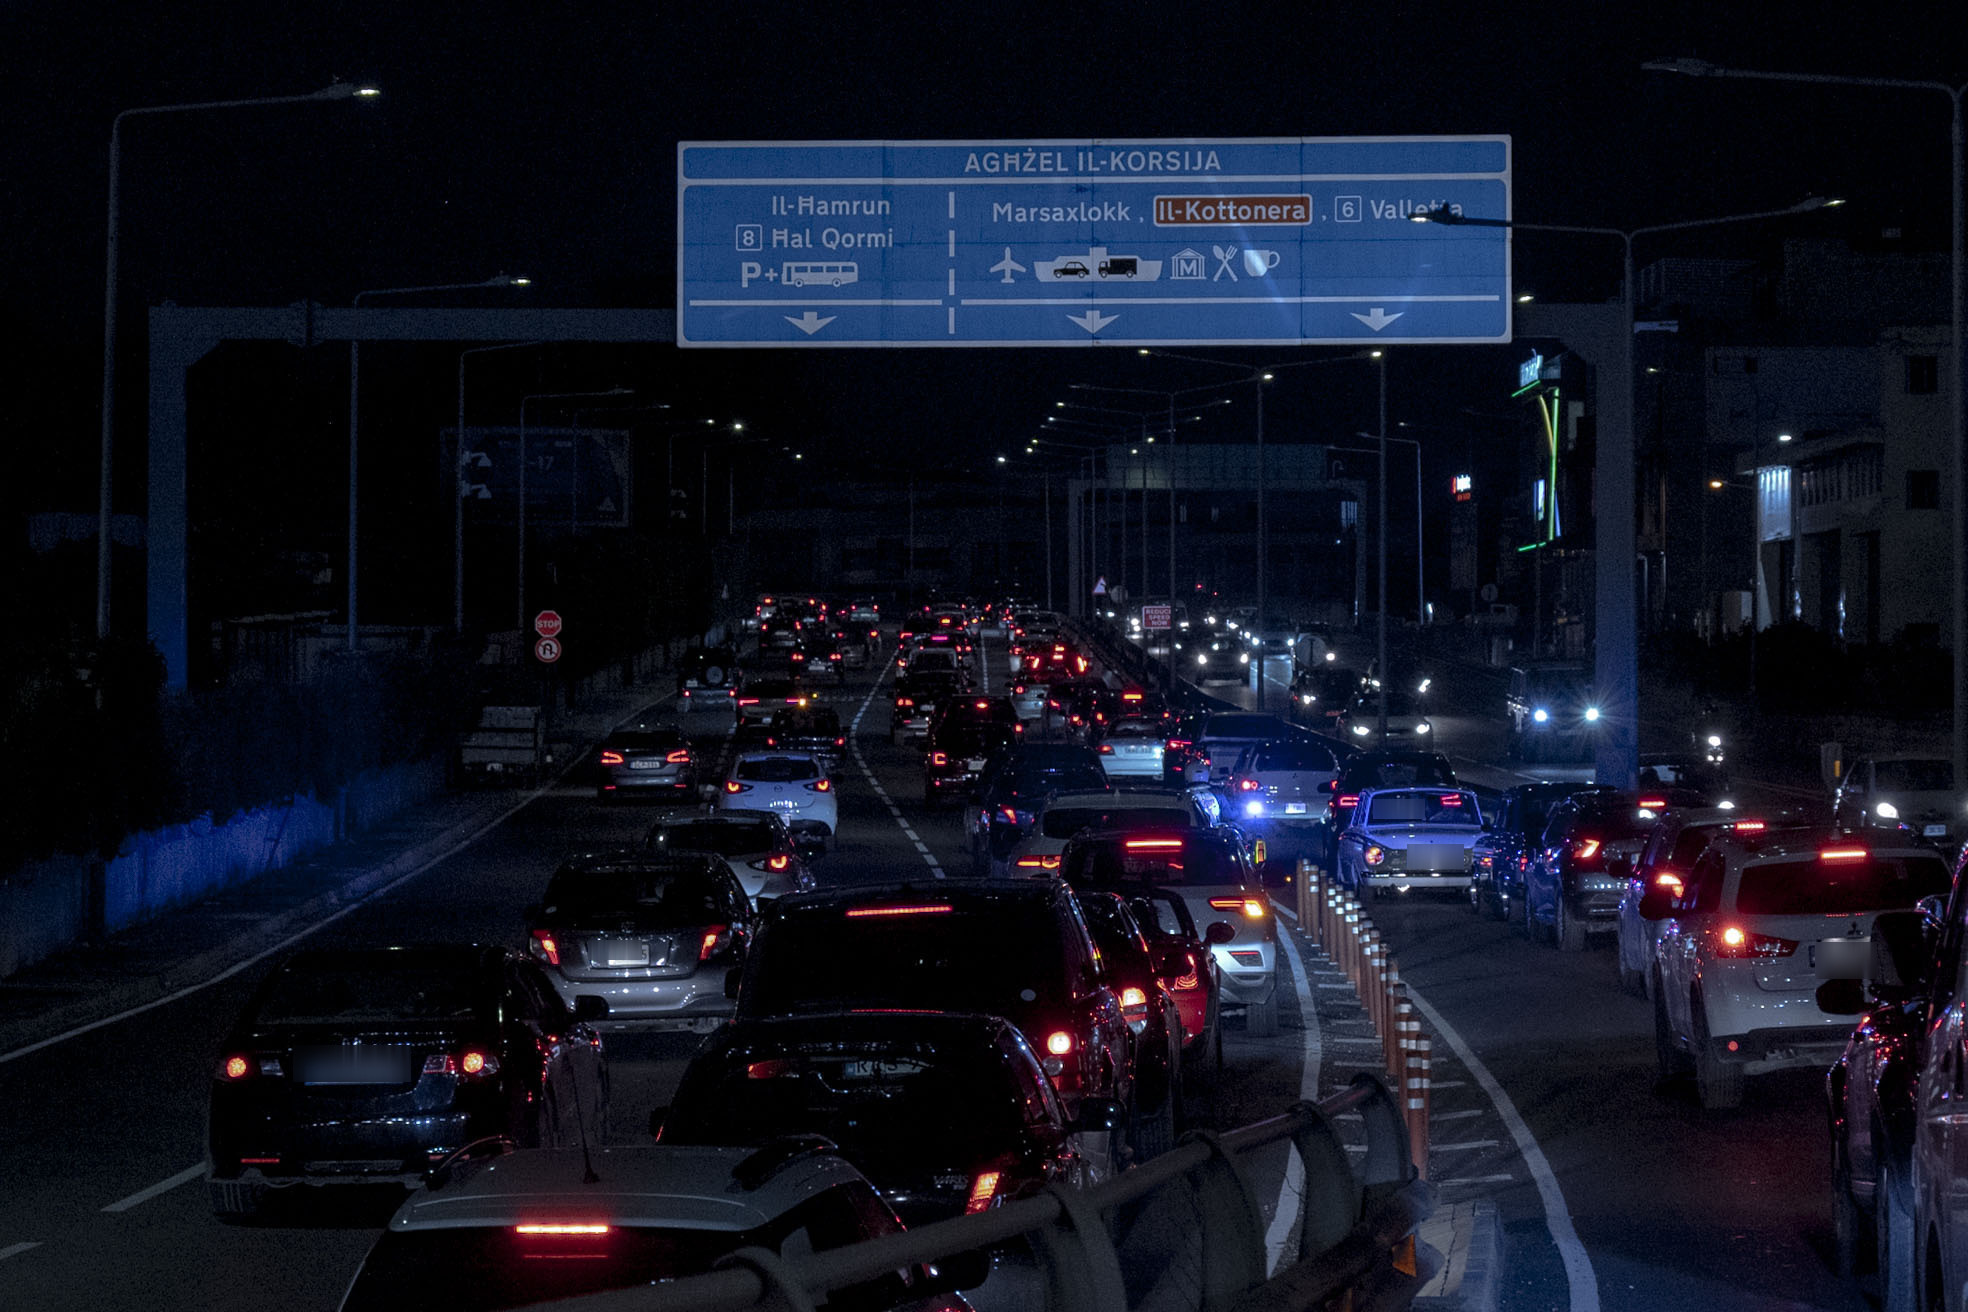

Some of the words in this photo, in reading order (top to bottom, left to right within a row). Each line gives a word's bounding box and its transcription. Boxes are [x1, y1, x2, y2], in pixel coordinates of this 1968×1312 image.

[965, 148, 1069, 173] AGĦŻEL
[1078, 150, 1222, 172] IL-KORSIJA
[772, 196, 891, 216] Il-Ħamrun
[994, 203, 1131, 223] Marsaxlokk
[1158, 198, 1306, 221] Il-Kottonera
[1342, 201, 1354, 217] 6
[1370, 199, 1463, 219] Valleta
[743, 230, 754, 246] 8
[772, 228, 813, 248] Ħal
[821, 227, 893, 250] Qormi
[537, 619, 560, 628] STOP
